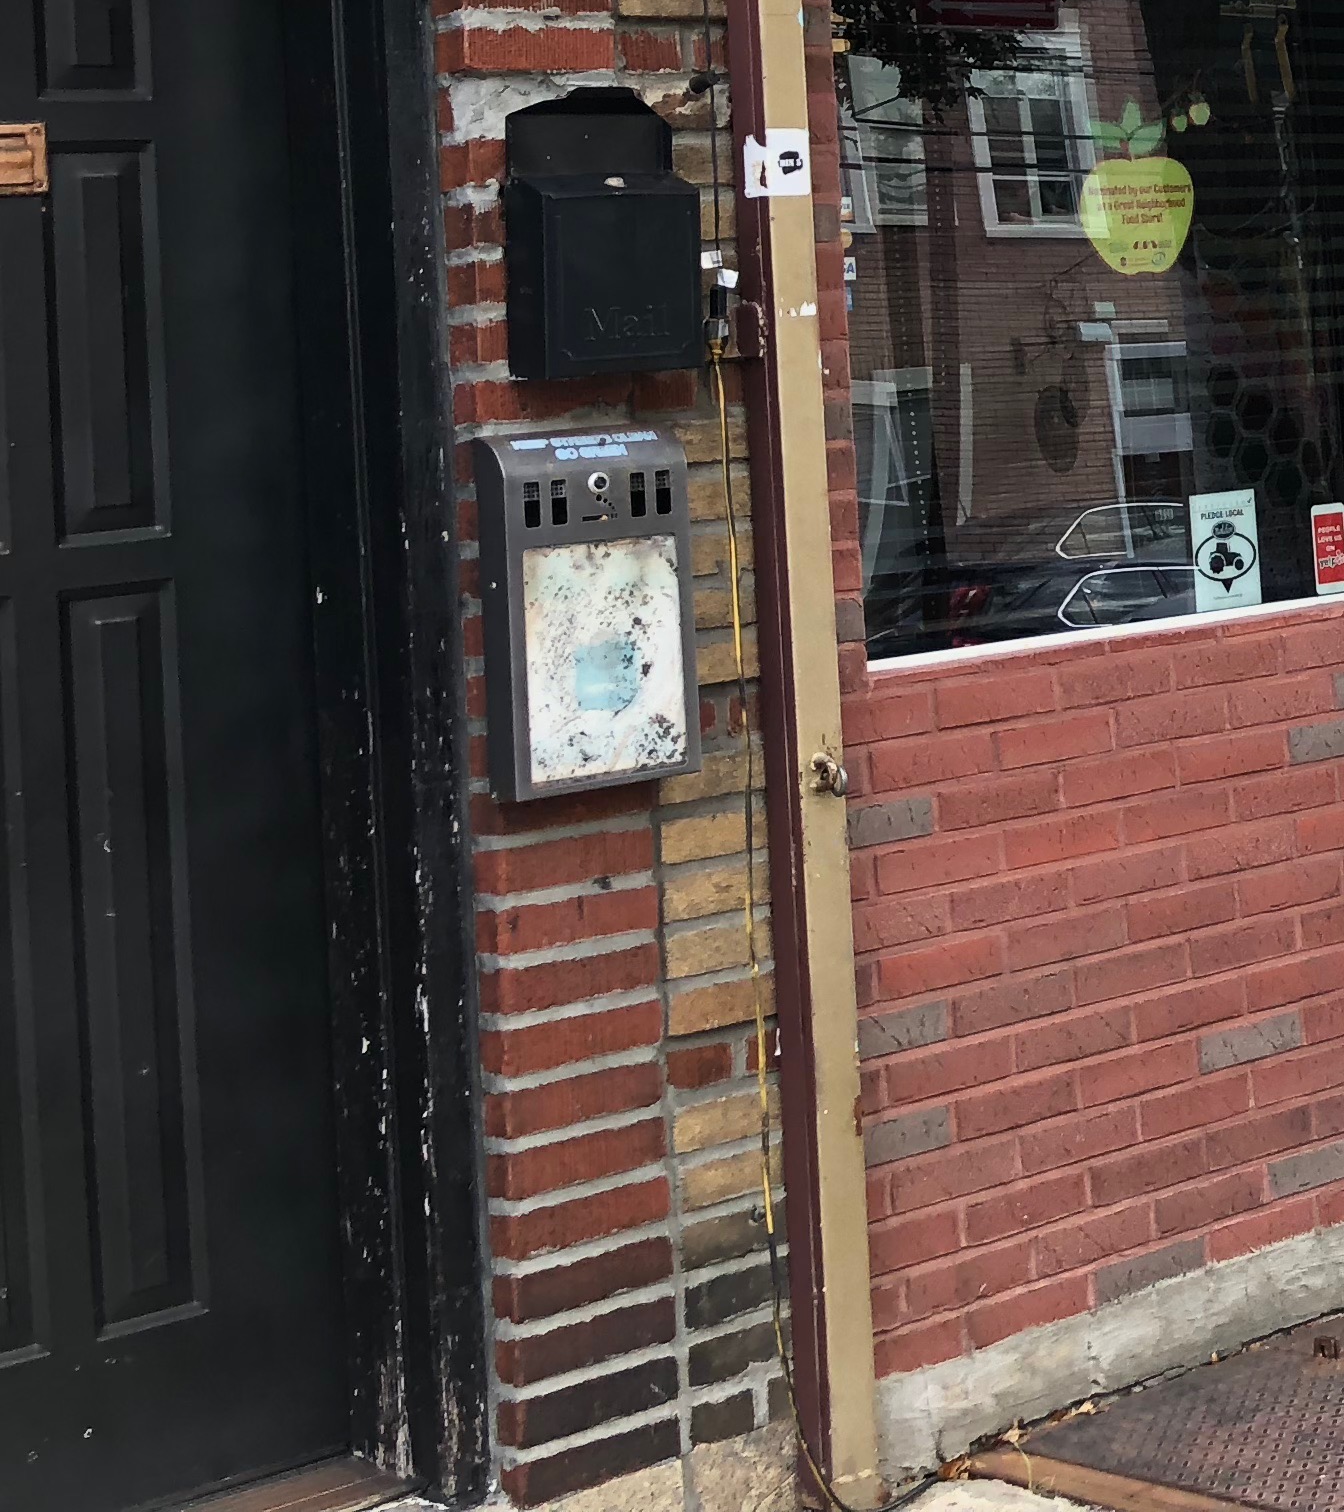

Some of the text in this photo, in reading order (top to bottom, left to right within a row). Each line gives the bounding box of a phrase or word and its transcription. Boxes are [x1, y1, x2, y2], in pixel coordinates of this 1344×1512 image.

[583, 302, 671, 341] Mail
[1200, 508, 1244, 521] PLEDGE LOCAL
[1317, 535, 1334, 544] LOVE
